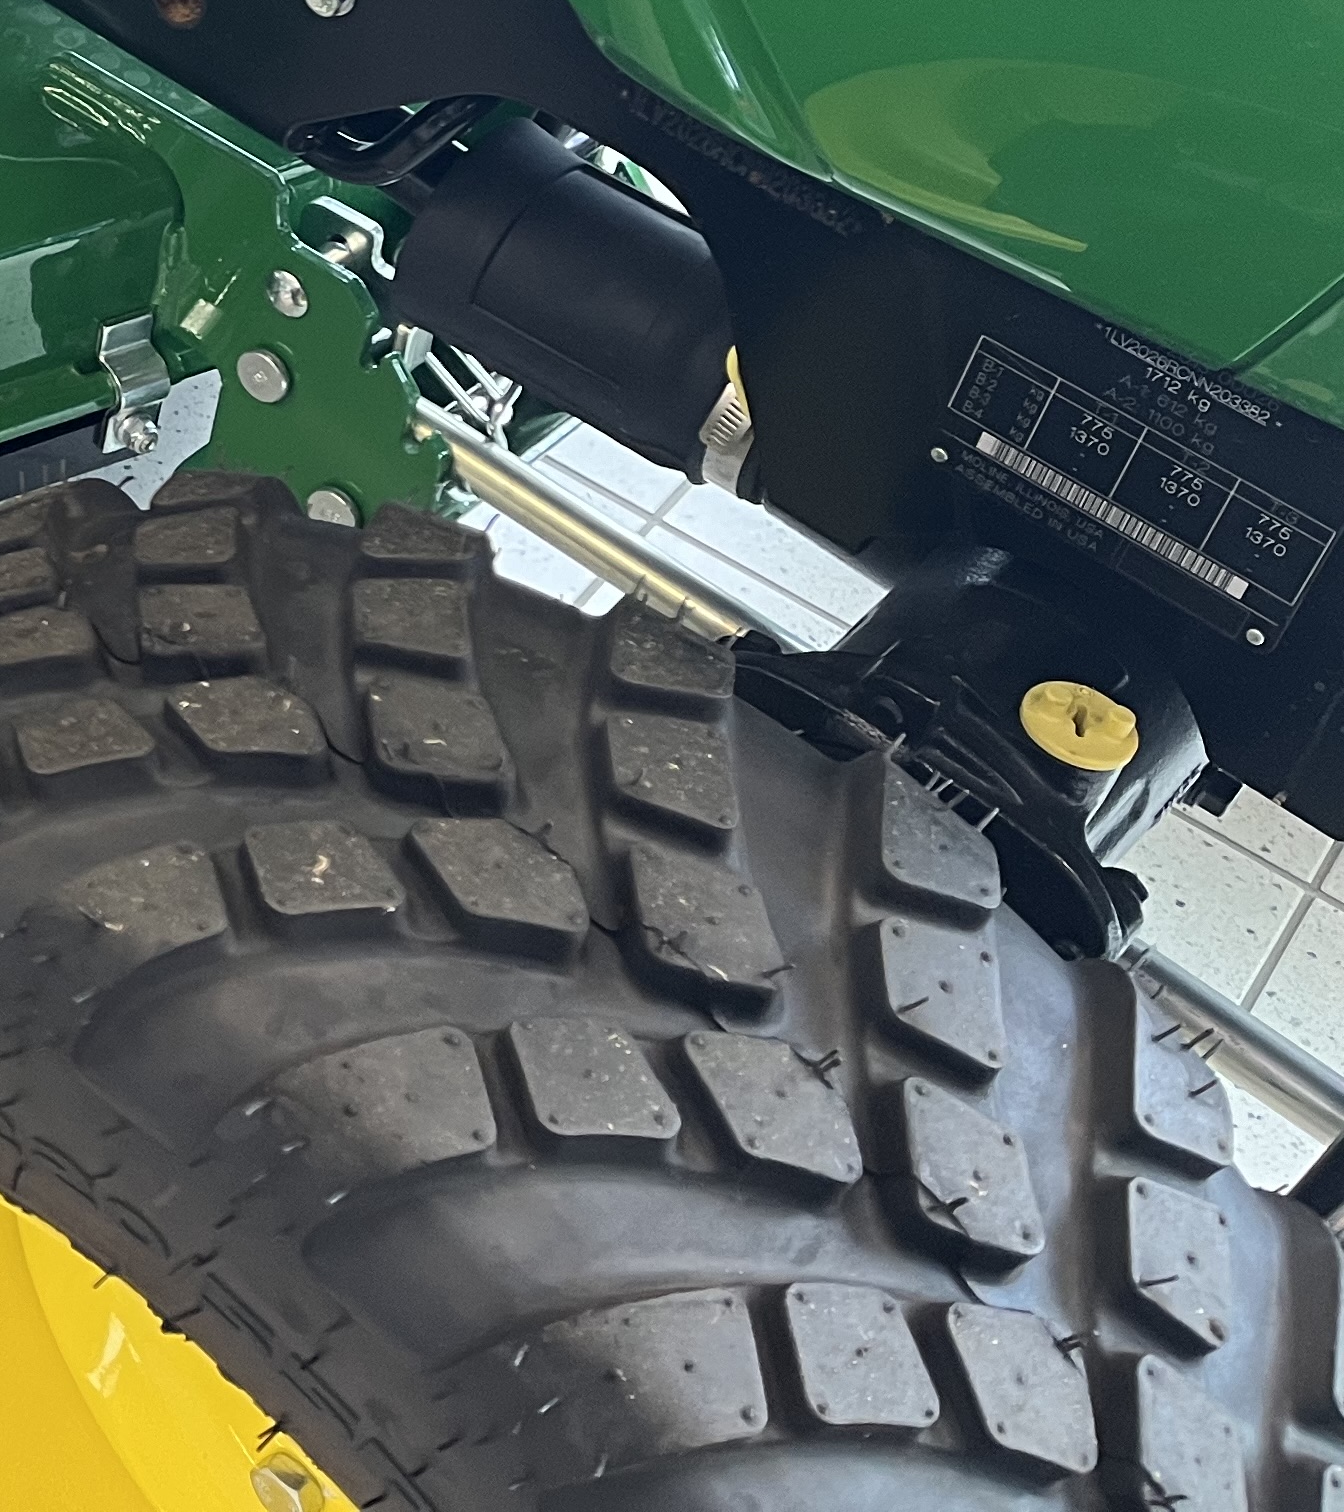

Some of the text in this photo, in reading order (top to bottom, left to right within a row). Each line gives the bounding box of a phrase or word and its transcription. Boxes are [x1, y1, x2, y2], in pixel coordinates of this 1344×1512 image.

[1145, 368, 1210, 411] 1712 kg
[1156, 394, 1187, 417] 612
[1146, 409, 1185, 436] 1100
[1068, 427, 1109, 455] 1370
[1158, 478, 1200, 506] 1370
[1244, 527, 1286, 556] 1370
[1080, 414, 1113, 439] 775
[1170, 466, 1203, 490] 775
[1257, 515, 1291, 539] 775
